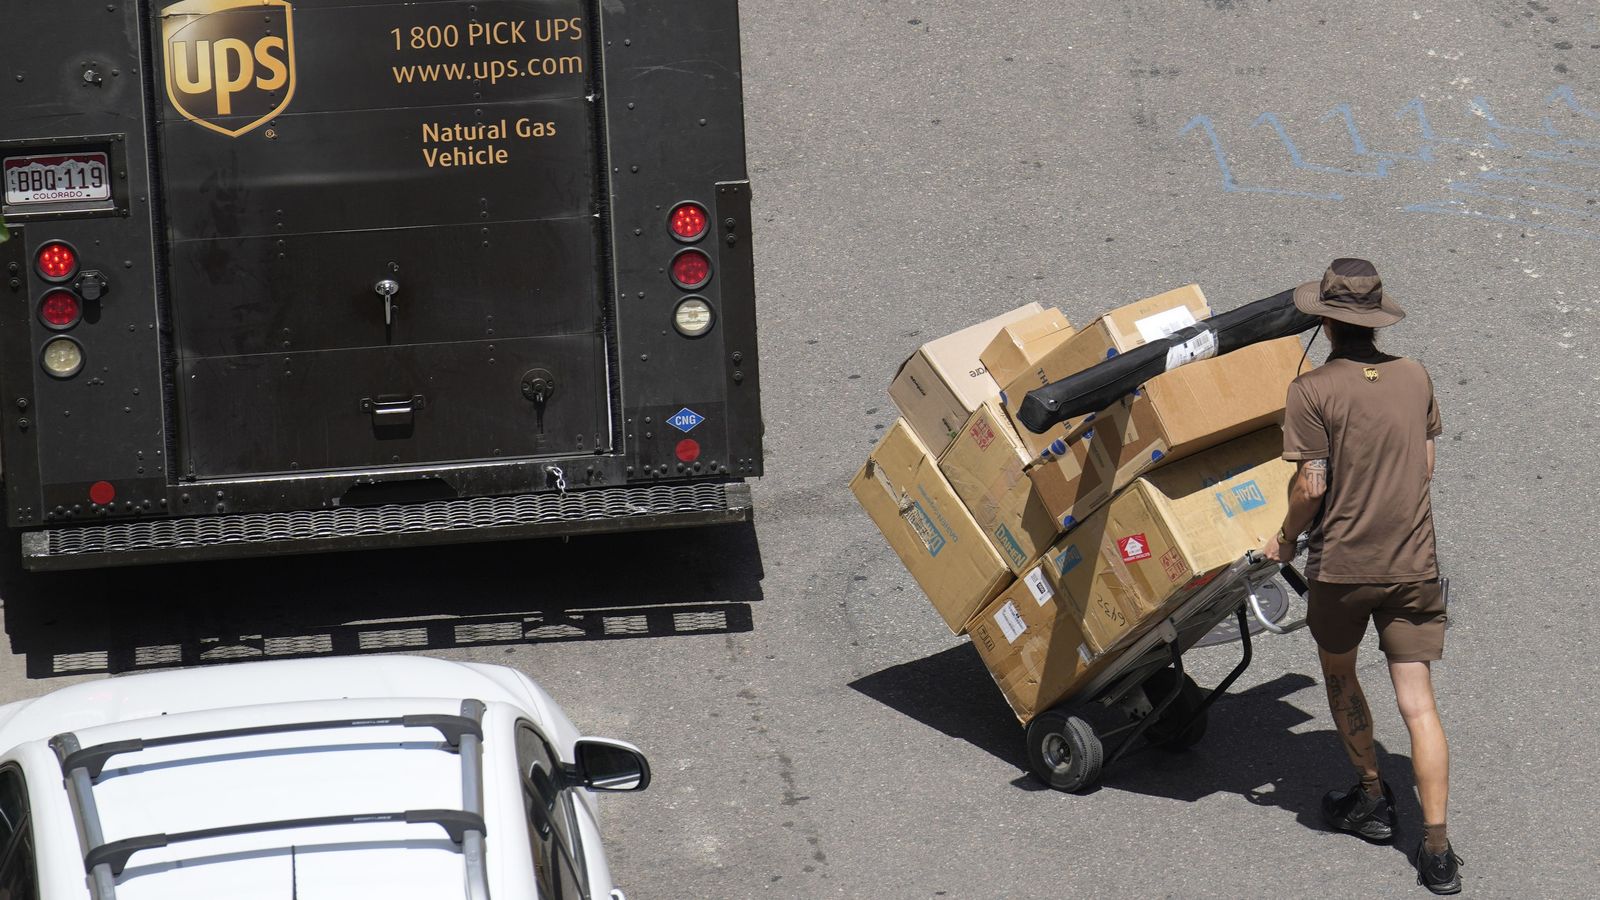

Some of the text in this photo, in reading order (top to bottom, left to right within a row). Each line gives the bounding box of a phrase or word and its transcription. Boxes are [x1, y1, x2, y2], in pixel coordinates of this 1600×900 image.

[387, 17, 582, 51] 1 800 PICK UPS
[173, 36, 287, 115] ups
[392, 56, 583, 85] www.ups.com
[422, 117, 557, 143] Natural Gas
[422, 145, 509, 168] Vehicle
[33, 191, 83, 200] COLORADO
[675, 415, 696, 426] CNG
[996, 527, 1027, 567] DAIHEN
